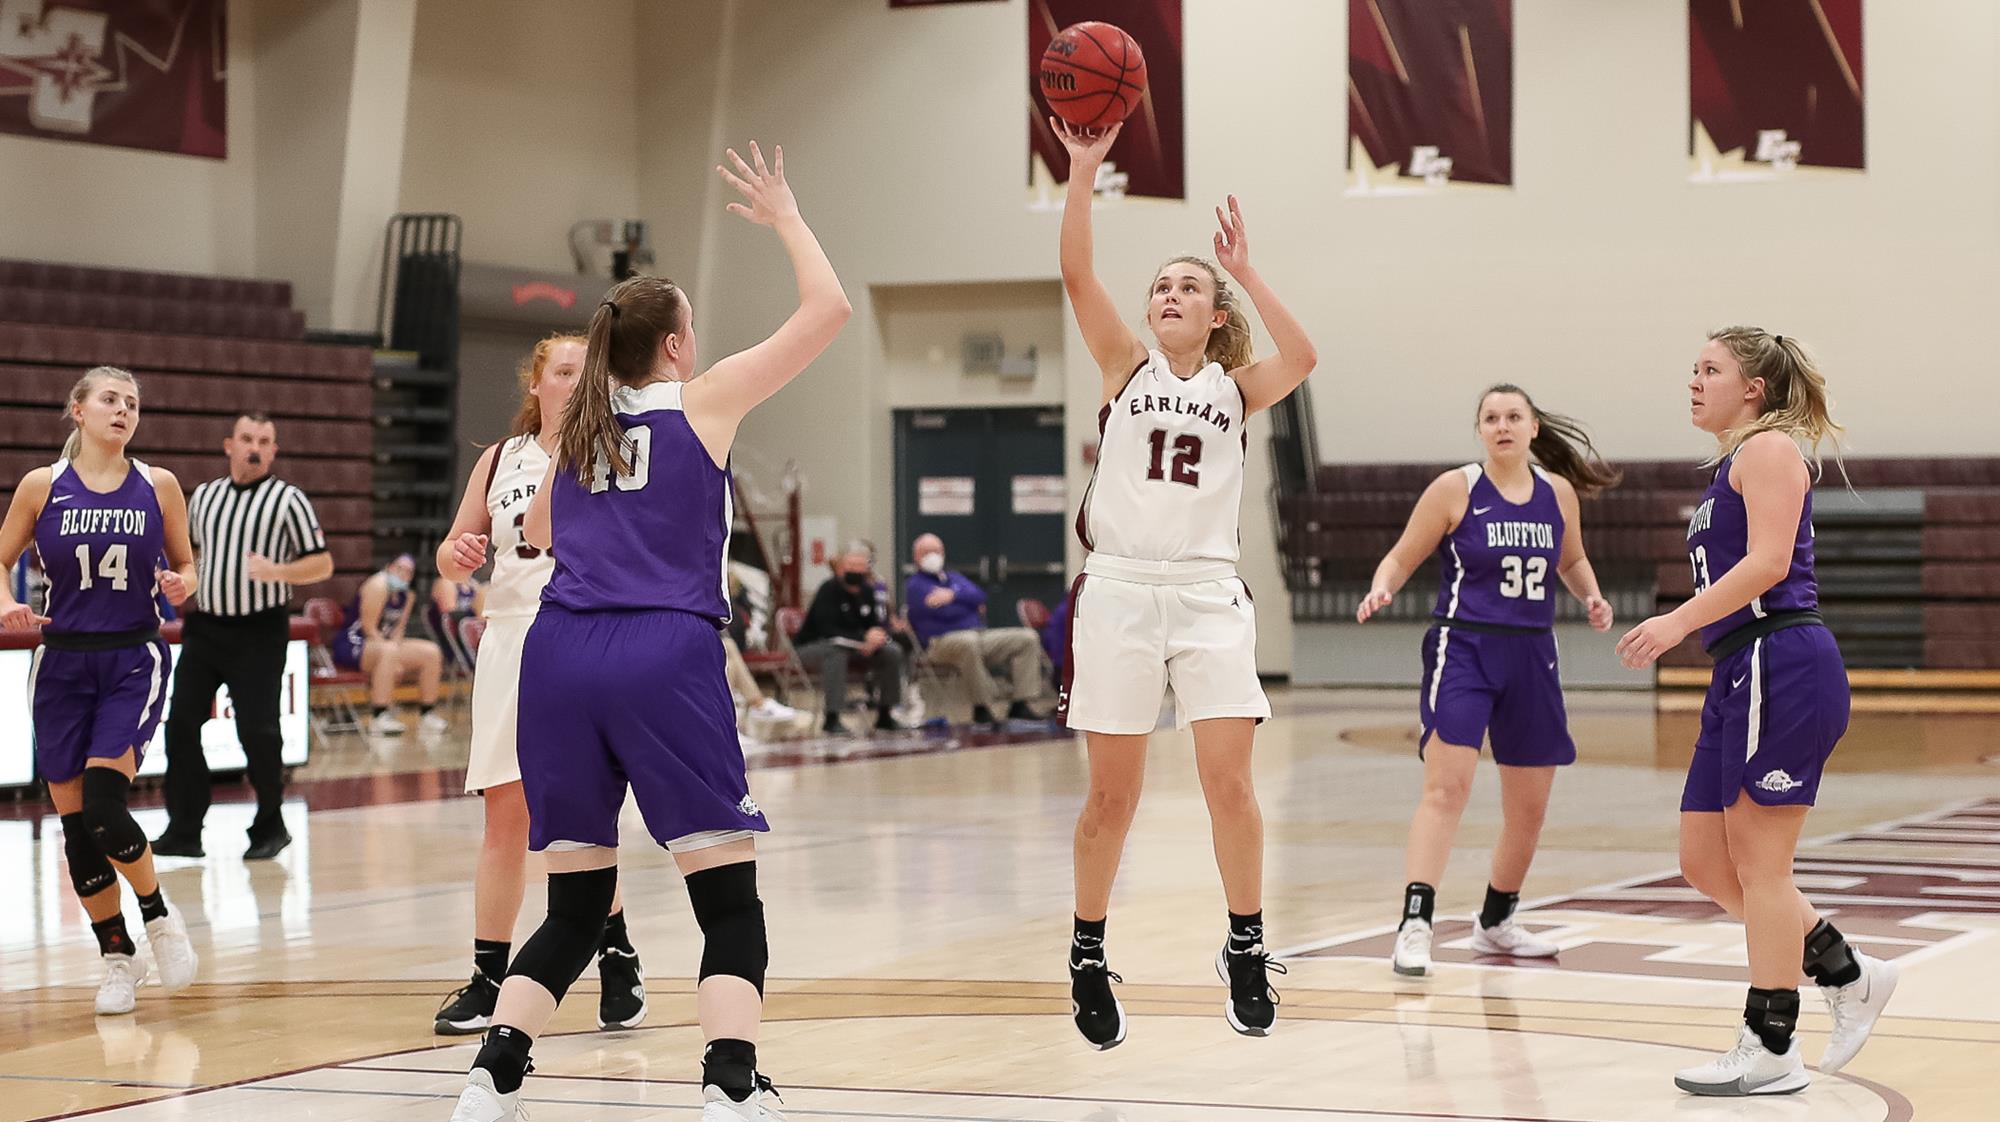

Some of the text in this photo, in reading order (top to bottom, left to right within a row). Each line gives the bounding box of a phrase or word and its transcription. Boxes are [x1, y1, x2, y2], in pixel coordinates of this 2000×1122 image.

[1130, 394, 1231, 433] EARLHAM
[1146, 427, 1204, 489] 12
[60, 508, 146, 536] BLUFFTON
[1486, 521, 1554, 550] BLUFFTON
[75, 543, 128, 591] 14
[1500, 554, 1548, 601] 32
